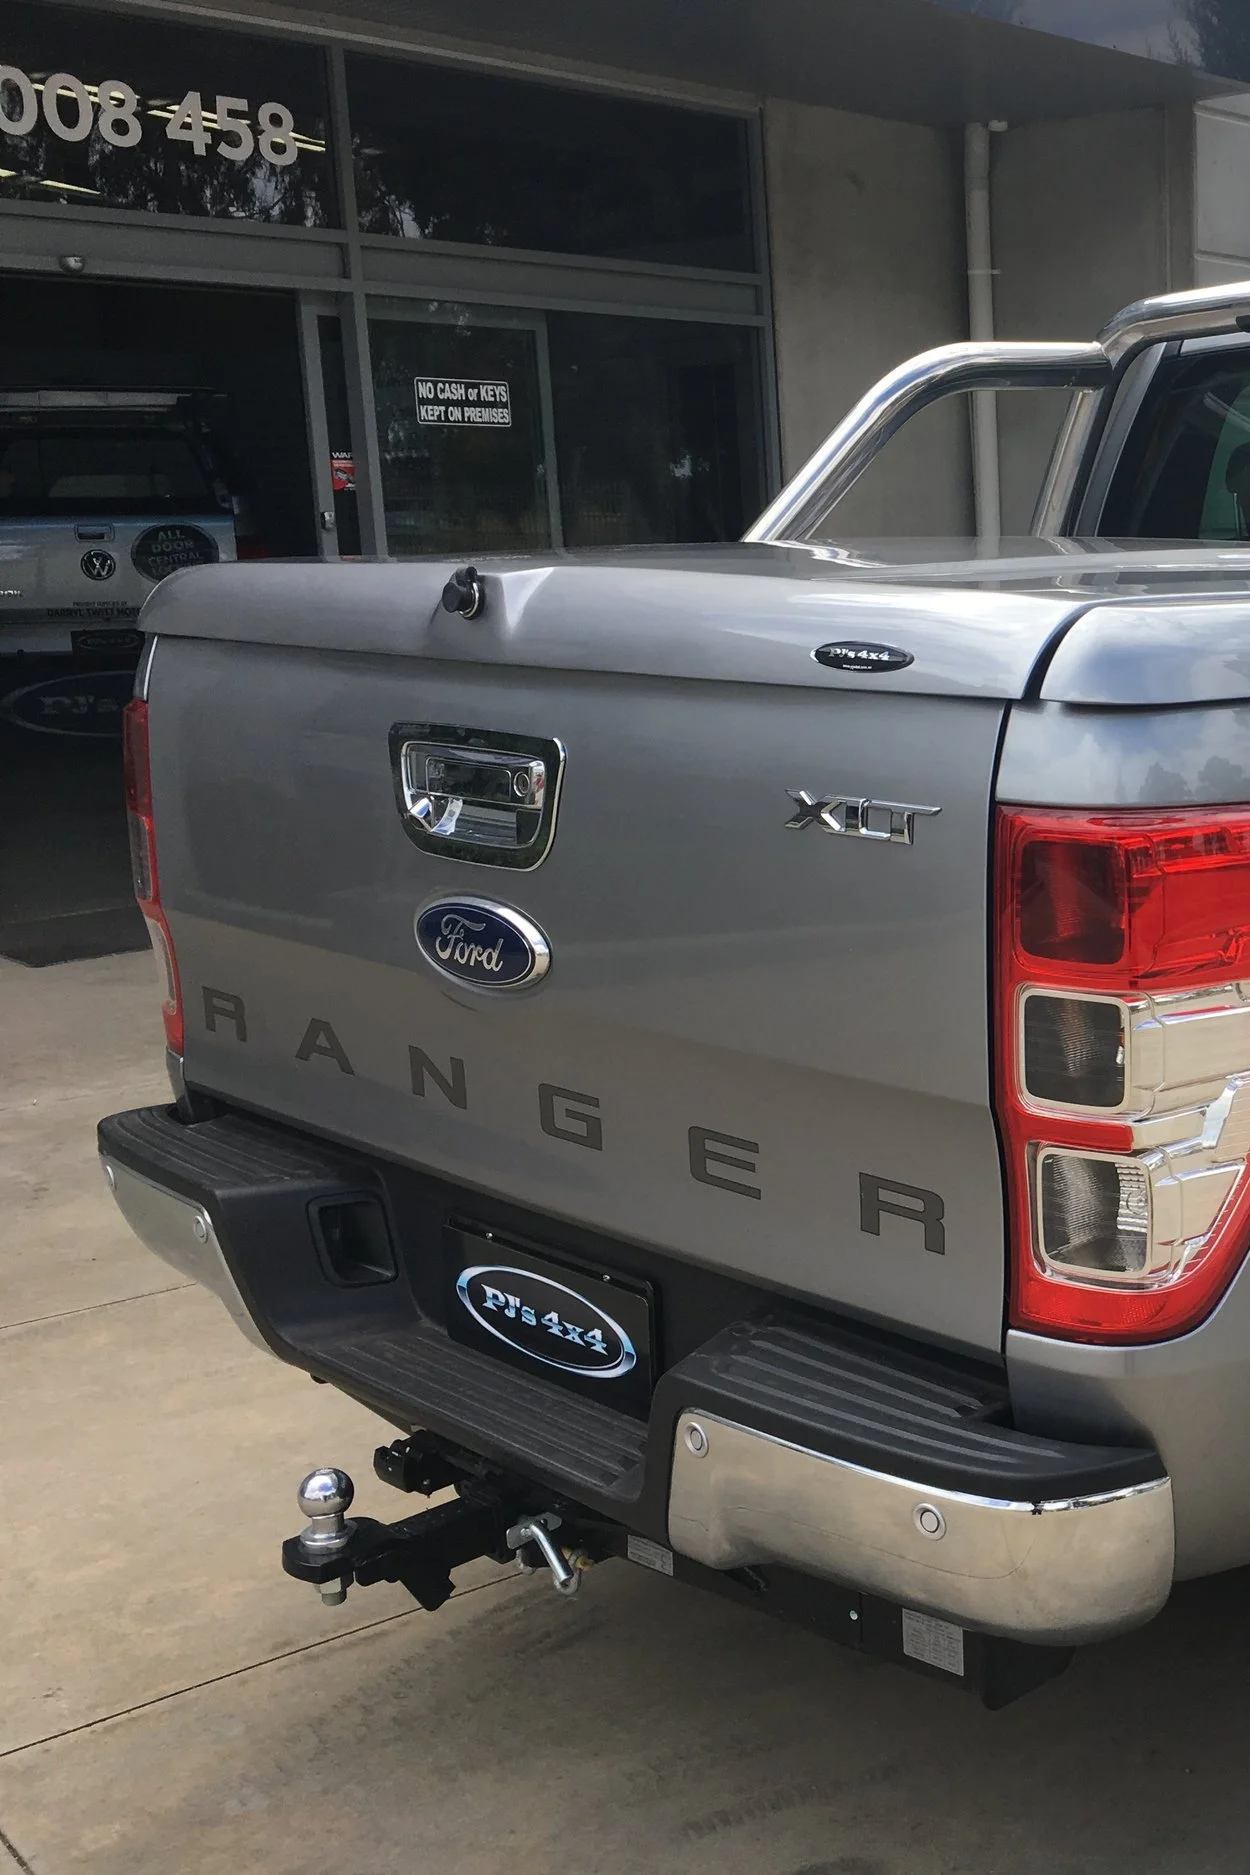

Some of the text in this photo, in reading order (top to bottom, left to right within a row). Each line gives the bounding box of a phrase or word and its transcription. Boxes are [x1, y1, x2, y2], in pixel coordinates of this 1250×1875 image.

[165, 91, 299, 166] 458
[418, 382, 507, 401] NO CASH or KEYS
[420, 405, 509, 423] KEPT ON PREMISES
[151, 539, 195, 553] DOOR
[157, 529, 186, 542] ALL
[784, 788, 943, 845] XLT
[435, 913, 504, 972] Ford
[201, 986, 946, 1256] RANGER
[480, 1283, 608, 1357] PJ's 4x4
